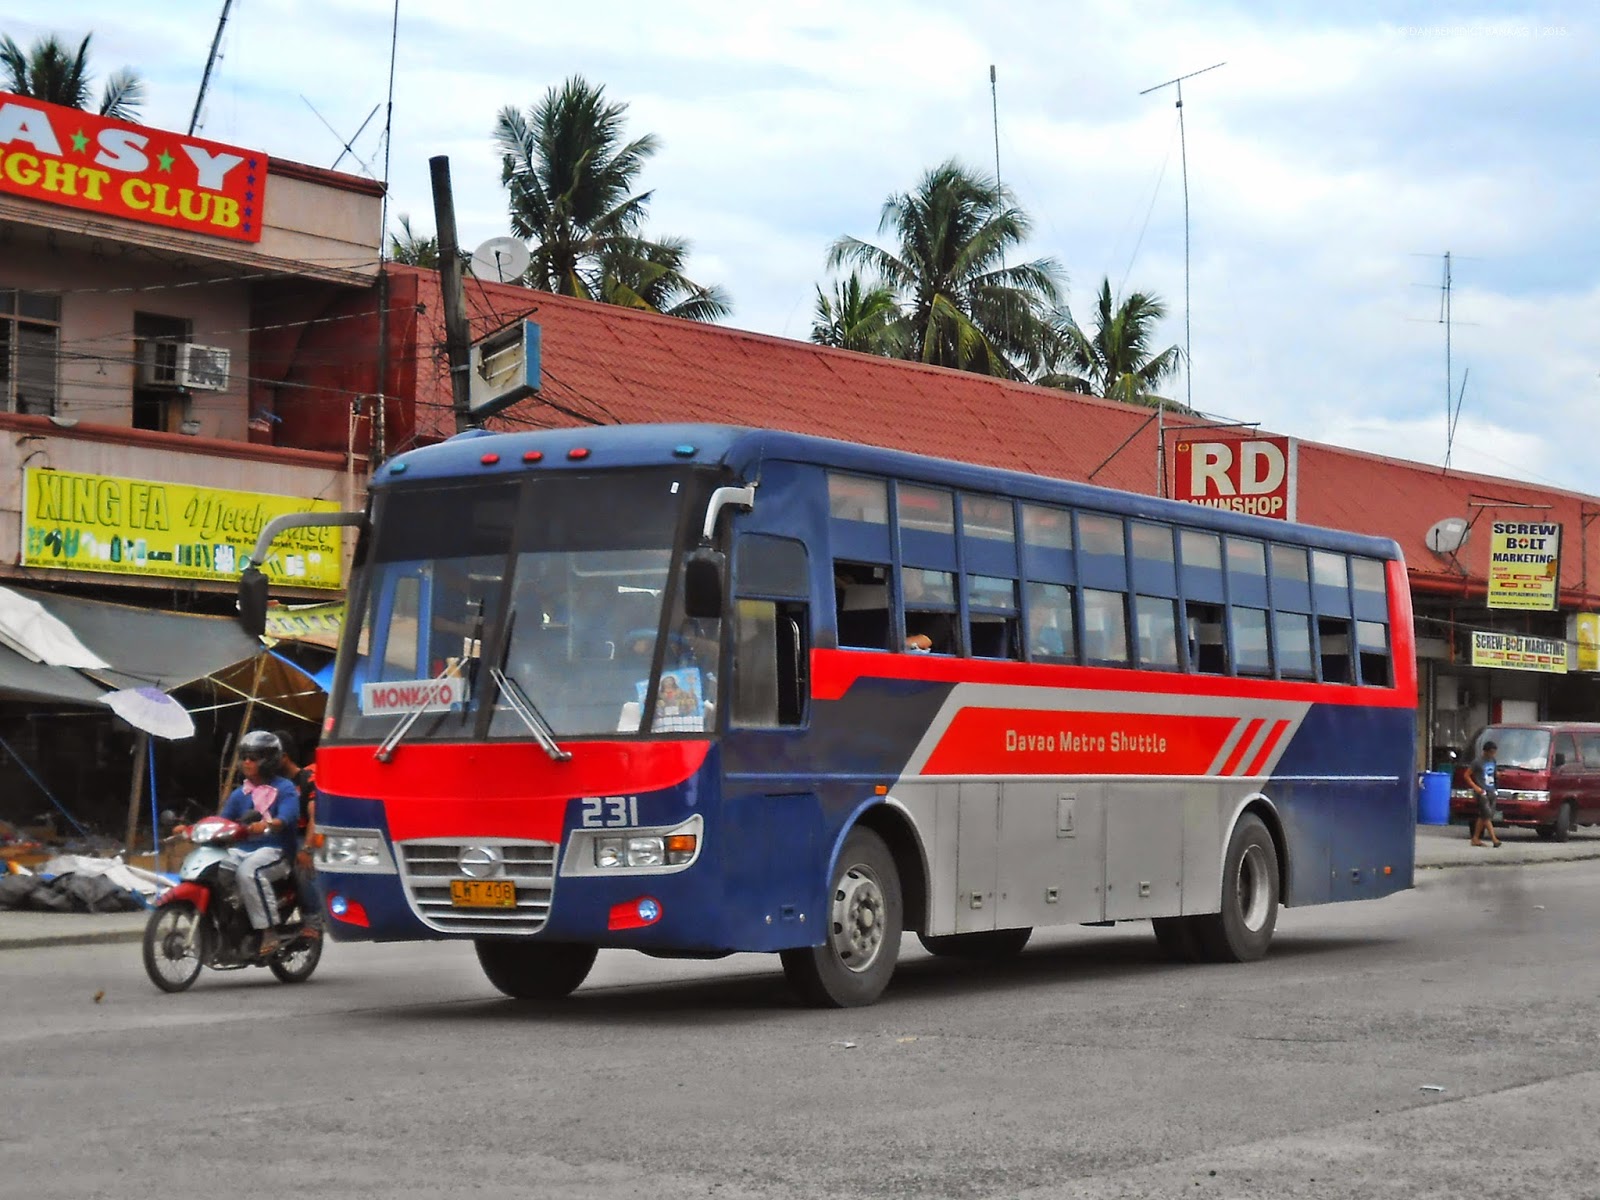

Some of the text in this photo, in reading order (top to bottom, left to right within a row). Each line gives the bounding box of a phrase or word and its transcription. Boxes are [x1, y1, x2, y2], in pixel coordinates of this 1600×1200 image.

[120, 178, 241, 229] CLUB
[1190, 440, 1286, 497] RD
[36, 472, 122, 527] XING
[129, 483, 169, 531] FA
[1179, 496, 1283, 515] WNSHOP
[1493, 523, 1557, 536] SCREW
[226, 536, 242, 544] New
[296, 542, 319, 551] Tagum
[321, 545, 334, 553] City
[1506, 538, 1547, 550] BOLT
[1493, 552, 1554, 564] MARKETING
[1525, 638, 1565, 657] MARKETING
[1005, 730, 1167, 753] Davao Metro Shuttle
[582, 796, 639, 827] 231
